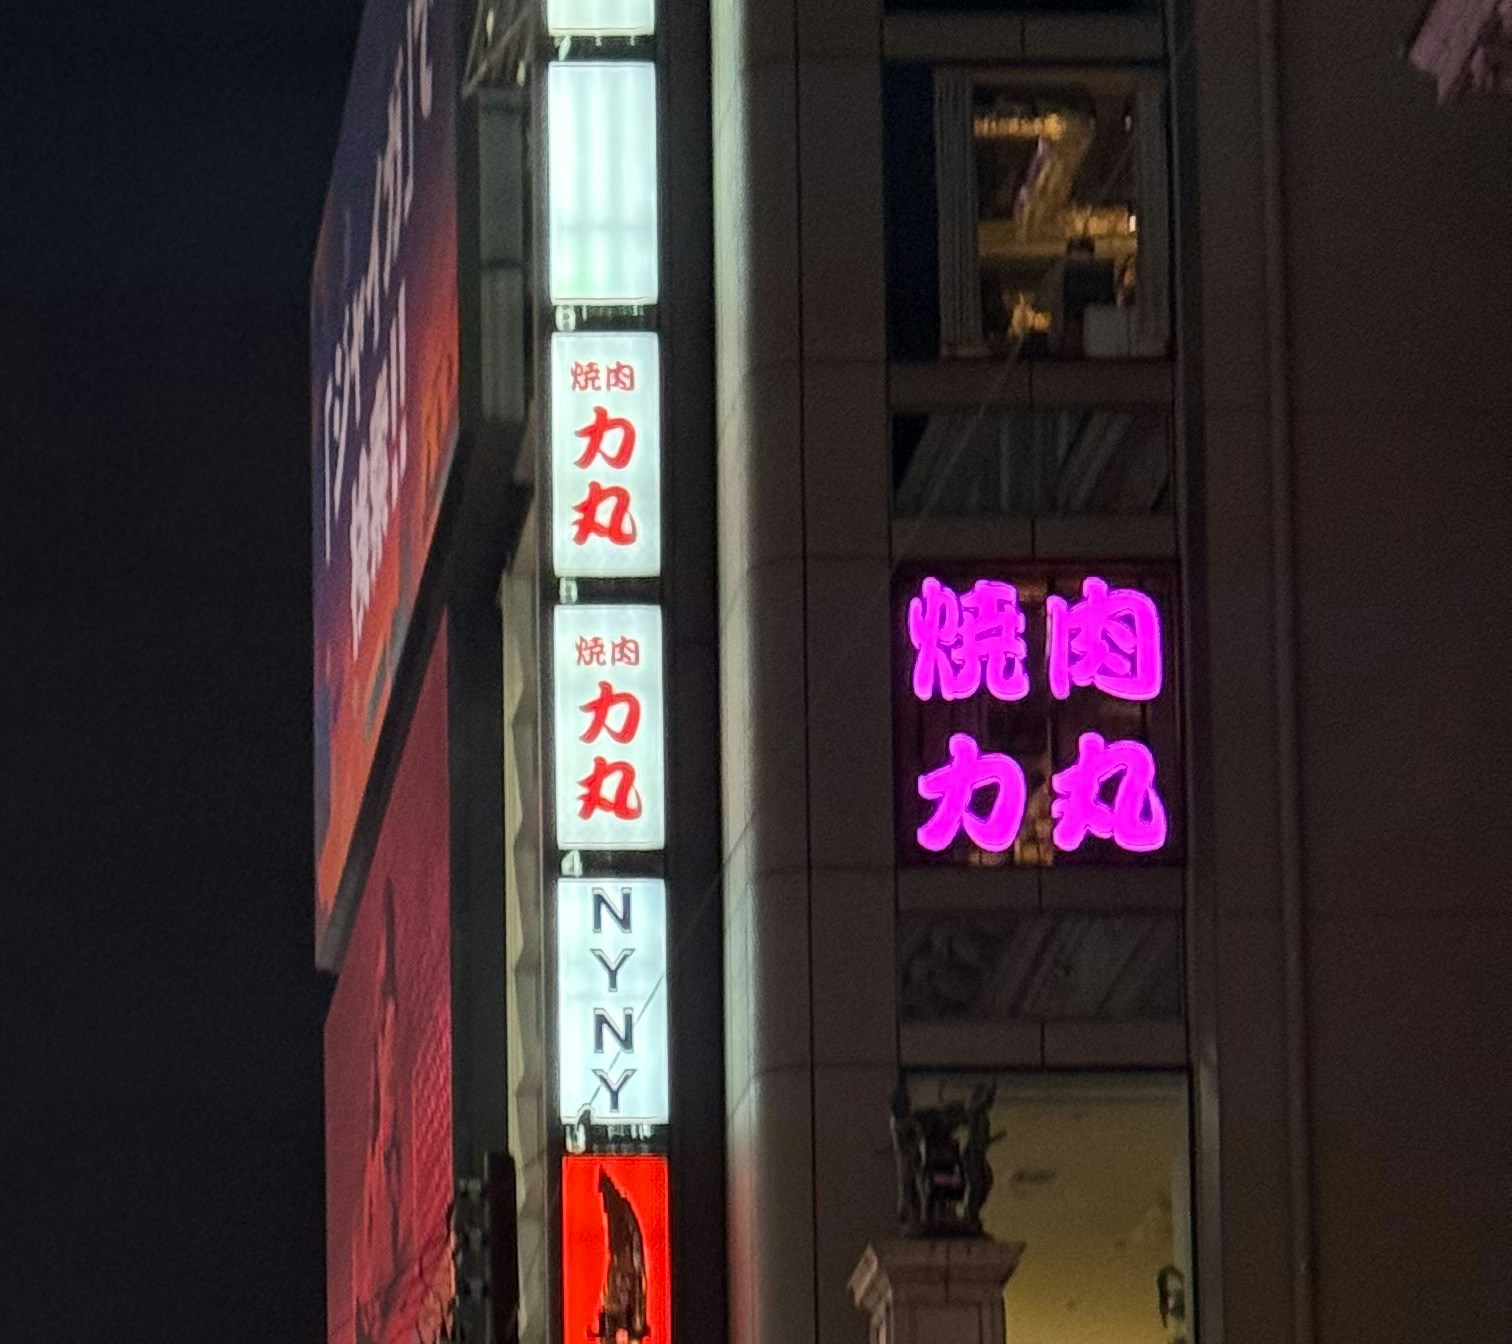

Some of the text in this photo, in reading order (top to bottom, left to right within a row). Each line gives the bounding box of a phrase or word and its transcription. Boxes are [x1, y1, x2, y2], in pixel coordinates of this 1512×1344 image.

[570, 360, 635, 392] 焼肉
[573, 405, 637, 546] 力丸
[574, 636, 641, 667] 焼肉
[909, 576, 1164, 703] 焼肉
[577, 680, 643, 821] 力丸
[916, 732, 1168, 853] 力丸
